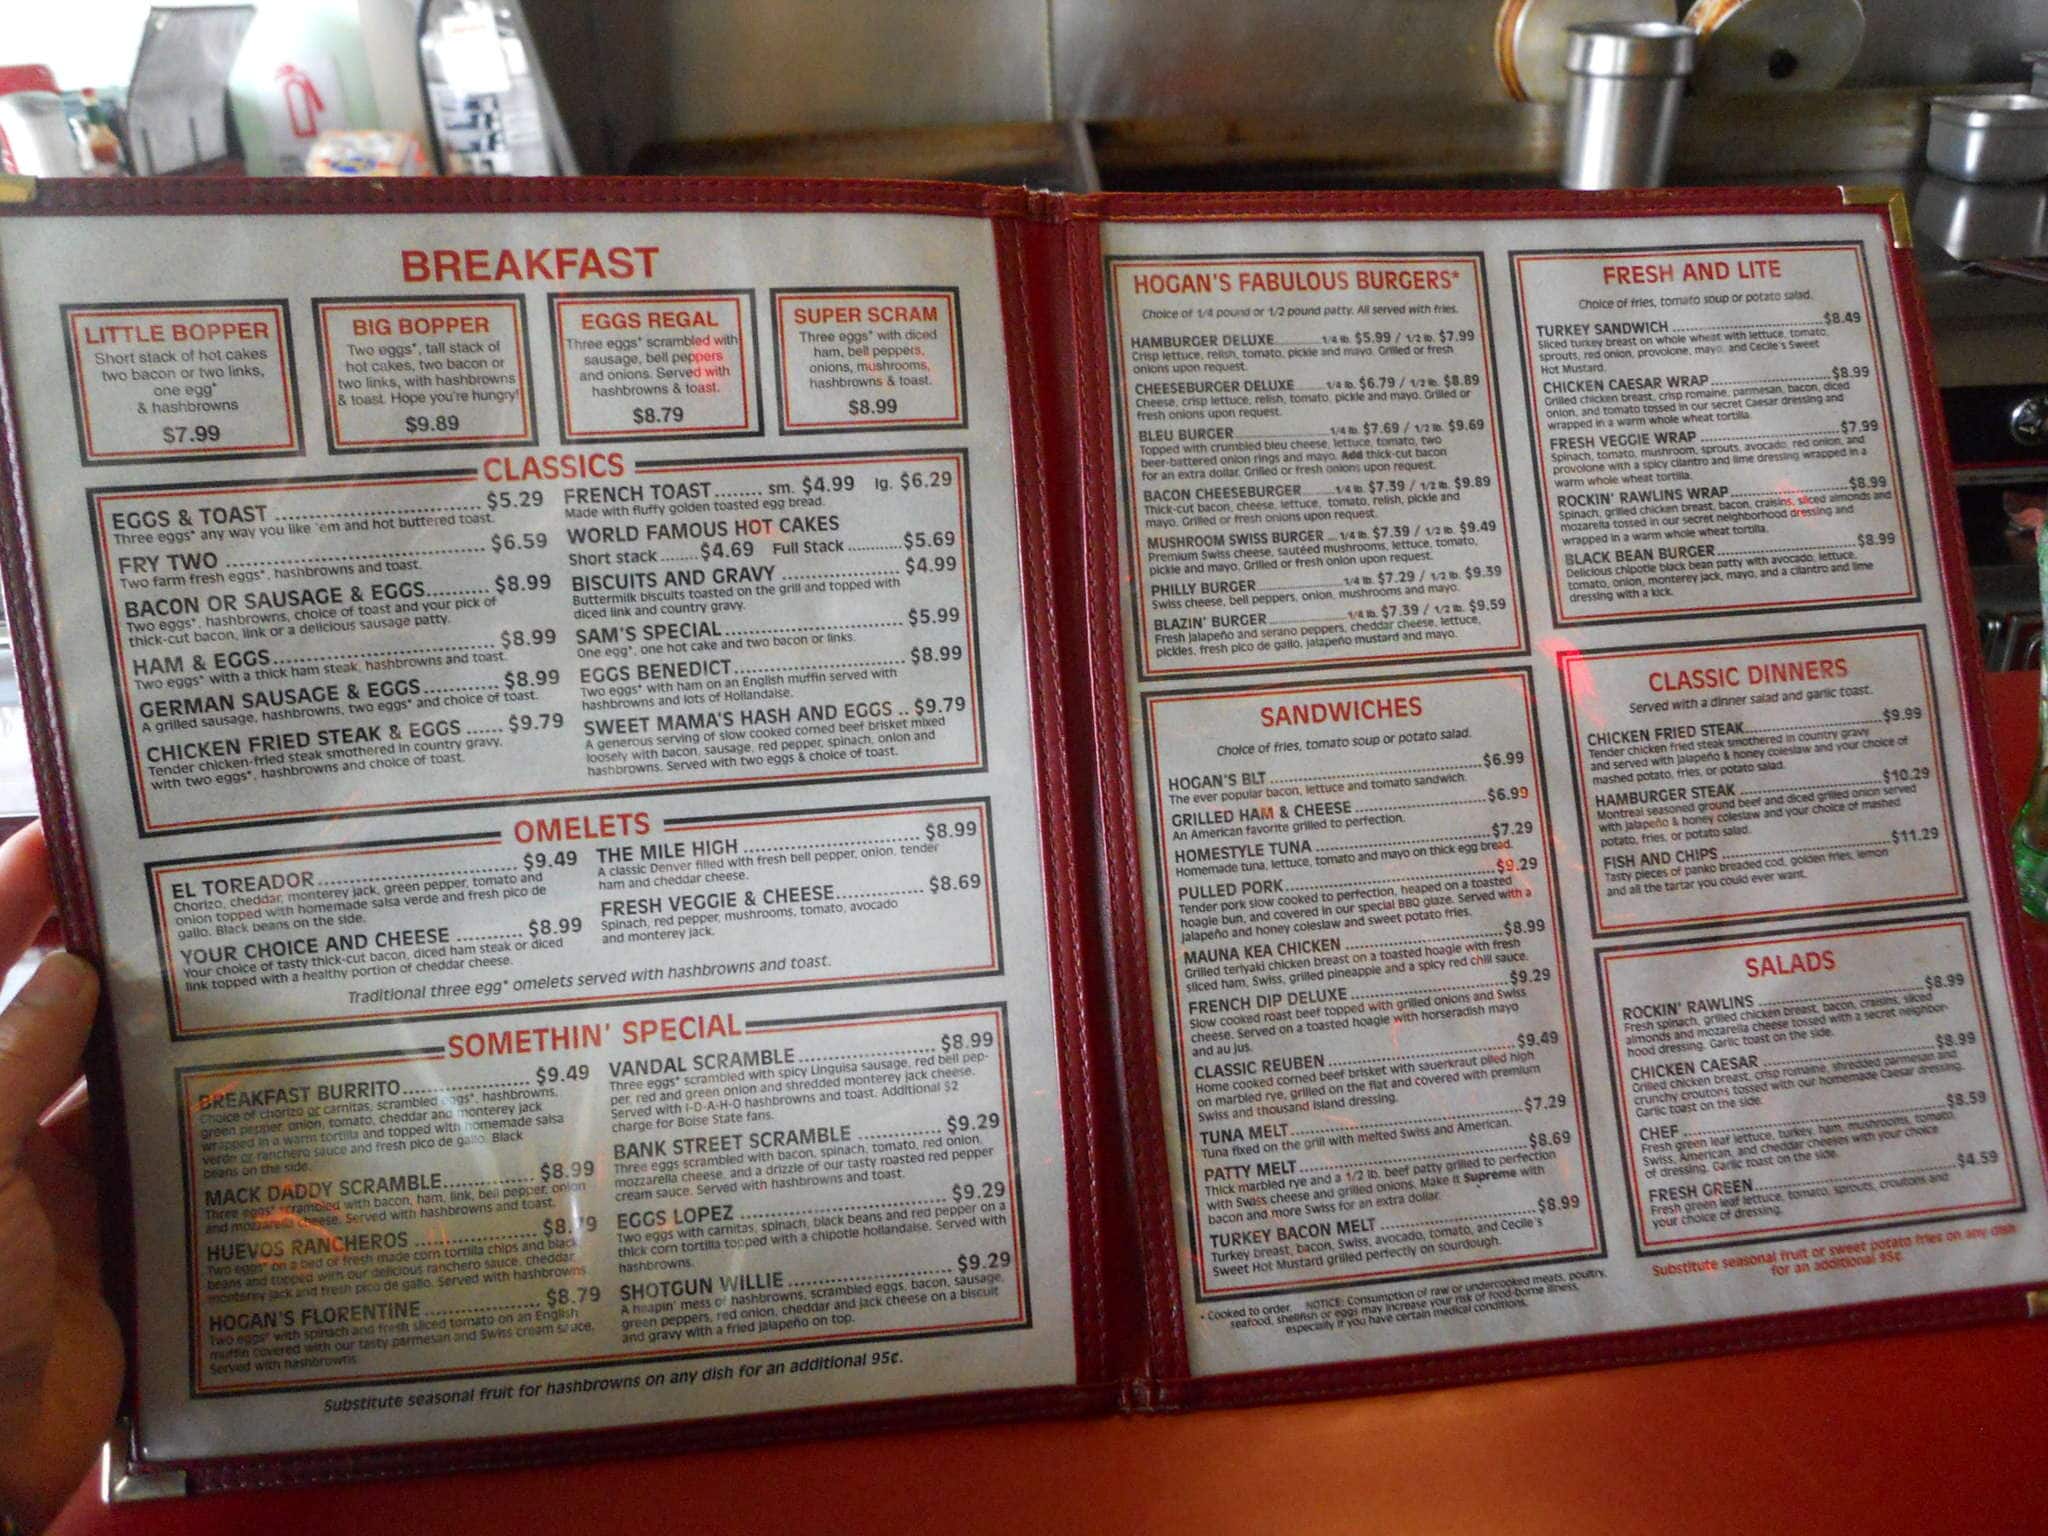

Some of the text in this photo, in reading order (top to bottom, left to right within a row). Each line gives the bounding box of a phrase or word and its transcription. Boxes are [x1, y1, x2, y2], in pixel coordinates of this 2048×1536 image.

[401, 247, 660, 283] BREAKFAST
[1603, 260, 1781, 285] FRESH AND LITE
[1134, 272, 1231, 294] HOGAN'S
[1239, 271, 1349, 292] FABULOUS
[353, 316, 489, 336] BIG BOPPER
[581, 312, 718, 329] EGGS REGAL
[794, 307, 937, 324] SUPER SCRAM
[1536, 312, 1861, 338] TURKEY SANDWICH $8.49
[84, 322, 269, 344] LITTLE BOPPER
[799, 331, 835, 343] Three
[877, 329, 901, 341] with
[905, 329, 937, 340] diced
[1131, 335, 1218, 349] HAMBURGER
[1223, 334, 1274, 347] DELUXE
[1355, 331, 1391, 344] $5.99
[1395, 330, 1401, 344] /
[1439, 330, 1474, 342] $7.99
[95, 347, 267, 365] Short stack of hot cakes
[632, 407, 683, 424] $8.79
[848, 399, 897, 415] $8.99
[163, 425, 220, 444] $7.99
[406, 415, 459, 433] $9.89
[482, 453, 624, 483] CLASSICS
[564, 472, 952, 505] FRENCH TOAST sm. $4.99 lg. $6.29
[112, 491, 544, 529] EGGS & TOAST $5.29
[568, 515, 840, 545] WORLD FAMOUS HOT CAKES
[119, 532, 548, 574] FRY TWO $6.59
[1565, 533, 1895, 566] BLACK BEAN BURGER $8.99
[120, 577, 150, 589] Two
[153, 574, 185, 586] farm
[189, 572, 225, 585] fresh
[274, 564, 353, 579] hashbrowns
[357, 562, 382, 575] and
[386, 559, 422, 572] toast.
[572, 556, 957, 592] BISCUITS AND GRAVY $4.99
[576, 608, 960, 646] SAM'S SPECIAL $5.99
[133, 629, 557, 676] HAM & EGGS $8.99
[580, 646, 962, 685] EGGS BENEDICT $8.99
[1649, 658, 1848, 693] CLASSIC DINNERS
[1260, 697, 1423, 728] SANDWICHES
[1588, 707, 1922, 747] CHICKEN FRIED STEAK $9.99
[146, 713, 564, 763] CHICKEN FRIED STEAK & EGGS $9.79
[1217, 728, 1472, 757] Choice of fries, tomato soup or potato salad.
[1169, 752, 1524, 791] HOGAN'S BLT $6.99
[514, 812, 651, 844] OMELETS
[597, 821, 977, 863] THE MILE HIGH $8.99
[1604, 827, 1939, 870] FISH AND CHIPS $11.29
[172, 851, 577, 899] EL TOREADOR $9.49
[1178, 857, 1538, 901] PULLED PORK $9.29
[600, 874, 981, 917] FRESH VEGGIE & CHEESE $8.69
[349, 986, 426, 1004] Traditional
[431, 983, 471, 998] three
[513, 974, 573, 993] omelets
[577, 969, 627, 987] served
[631, 966, 663, 982] with
[667, 960, 755, 979] hashbrowns
[759, 958, 787, 971] and
[791, 955, 831, 969] toast.
[1746, 950, 1836, 978] SALADS
[449, 1013, 743, 1059] SOMETHIN' SPECIAL
[609, 1032, 993, 1079] VANDAL SCRAMBLE $8.99
[200, 1065, 589, 1110] BREAKFAST BURRITO $9.49
[1200, 1094, 1566, 1145] TUNA MELT $7.29
[1640, 1125, 1679, 1142] CHEF
[617, 1182, 1005, 1230] EGGS LOPEZ $9.29
[1649, 1184, 1698, 1202] FRESH
[1702, 1178, 1754, 1197] GREEN
